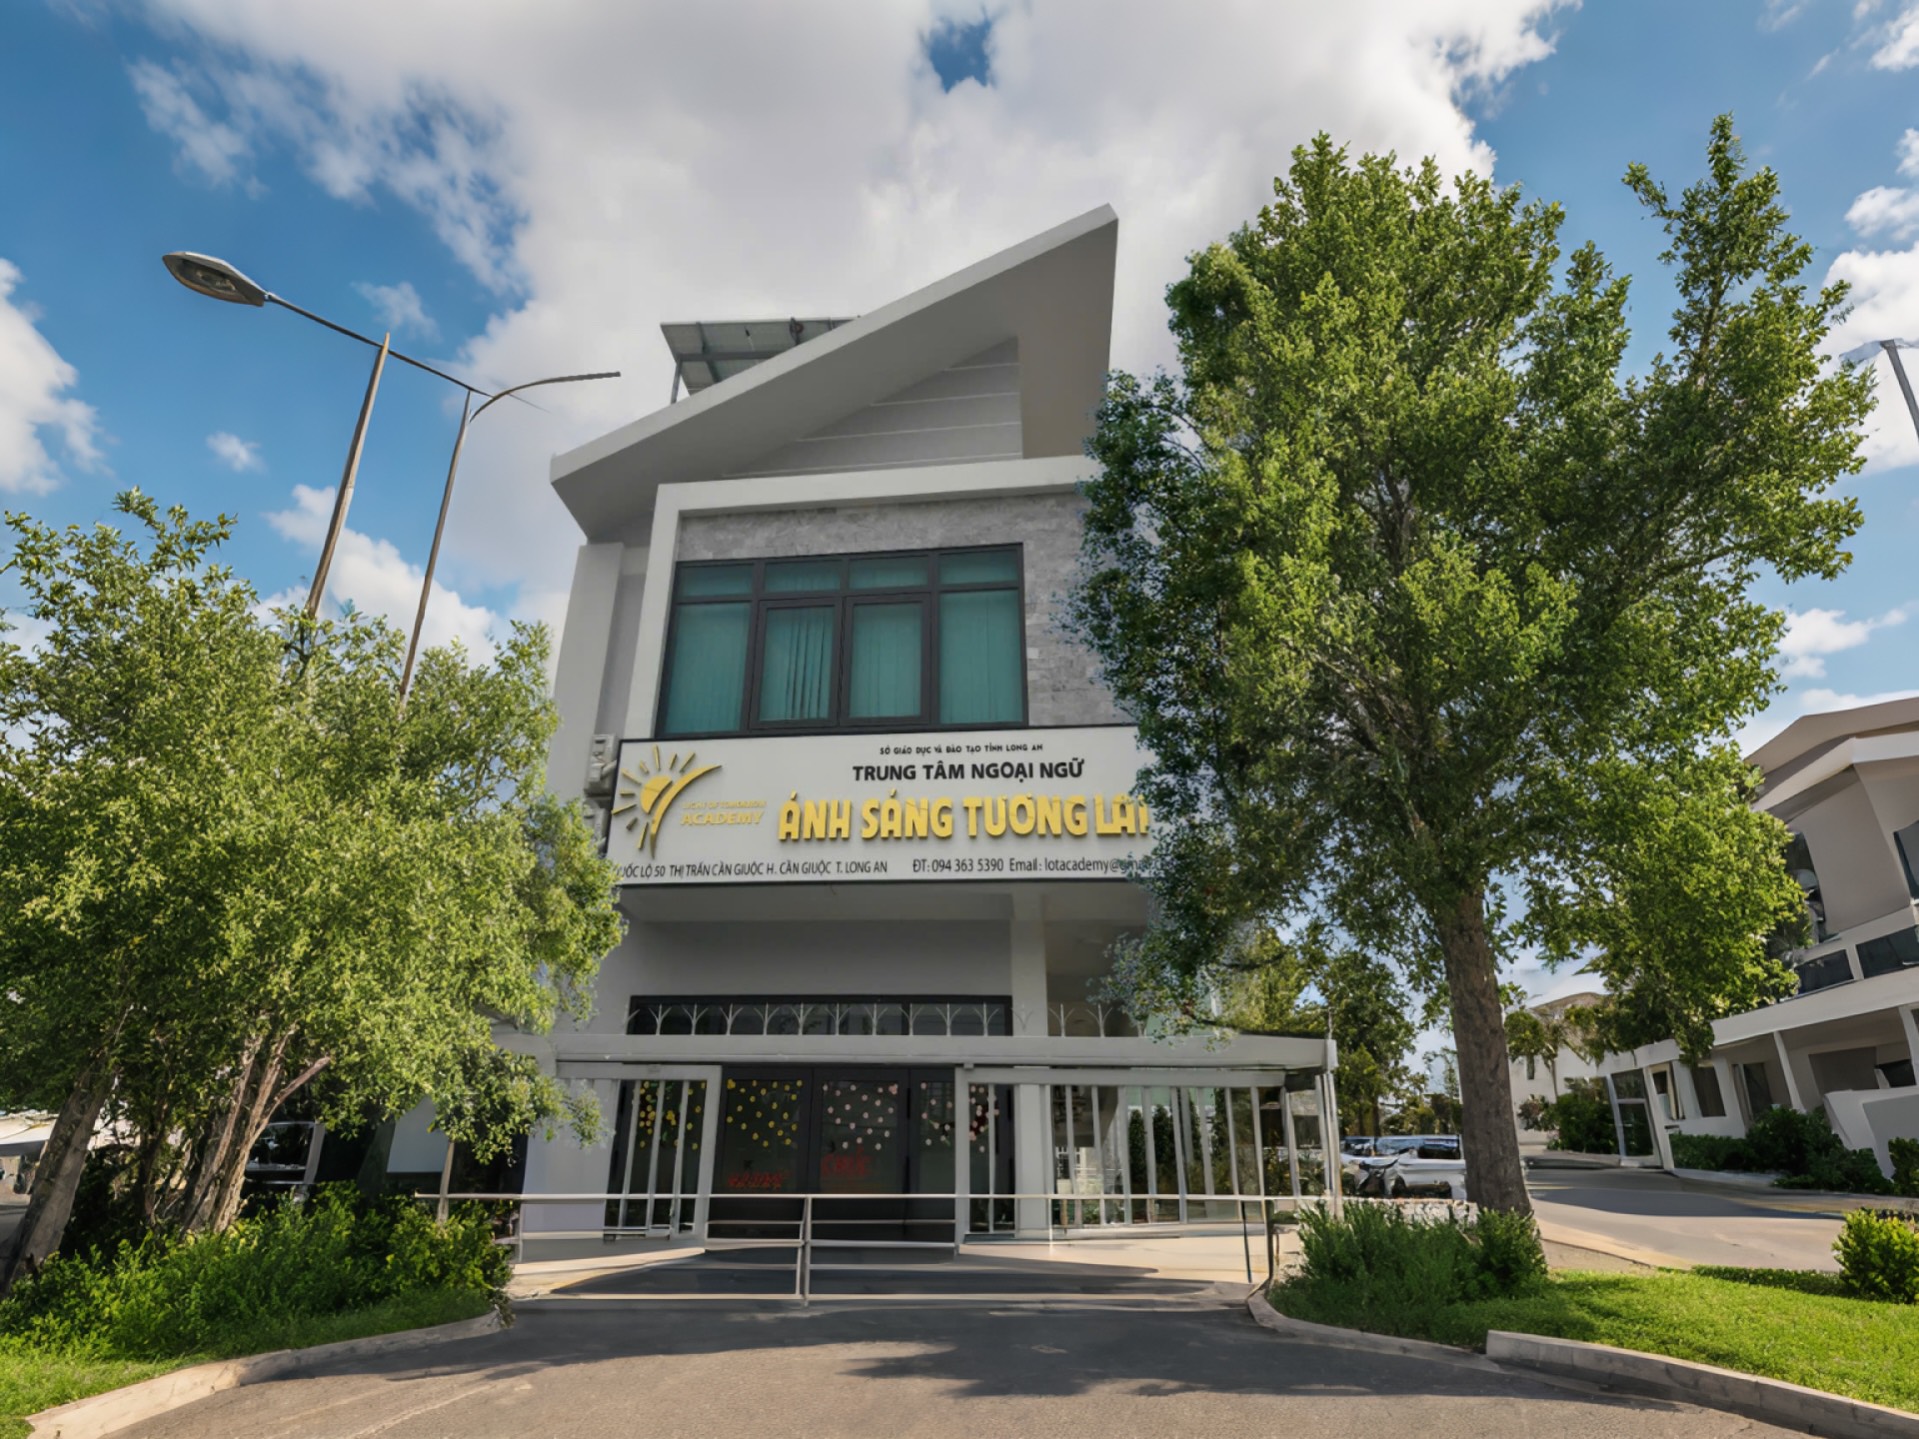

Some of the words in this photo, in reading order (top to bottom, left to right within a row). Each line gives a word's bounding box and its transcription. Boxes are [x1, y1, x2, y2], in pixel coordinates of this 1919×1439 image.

[1006, 744, 1028, 752] LONG
[852, 764, 917, 781] TRUNG
[922, 760, 965, 780] TÂM
[971, 761, 1034, 783] NGOẠI
[1040, 757, 1085, 779] NGỮ
[680, 811, 765, 825] ACADEMY
[778, 789, 852, 842] ÁNH
[861, 788, 954, 841] SÁNG
[962, 791, 1089, 838] TƯƠNG
[613, 861, 639, 878] UỐC
[640, 863, 653, 878] LỘ
[654, 864, 666, 877] 50
[845, 860, 871, 874] LONG
[873, 860, 888, 873] AN
[931, 858, 952, 872] 094
[954, 858, 974, 872] 363
[977, 857, 1004, 872] 5390
[1009, 857, 1042, 872] Email:
